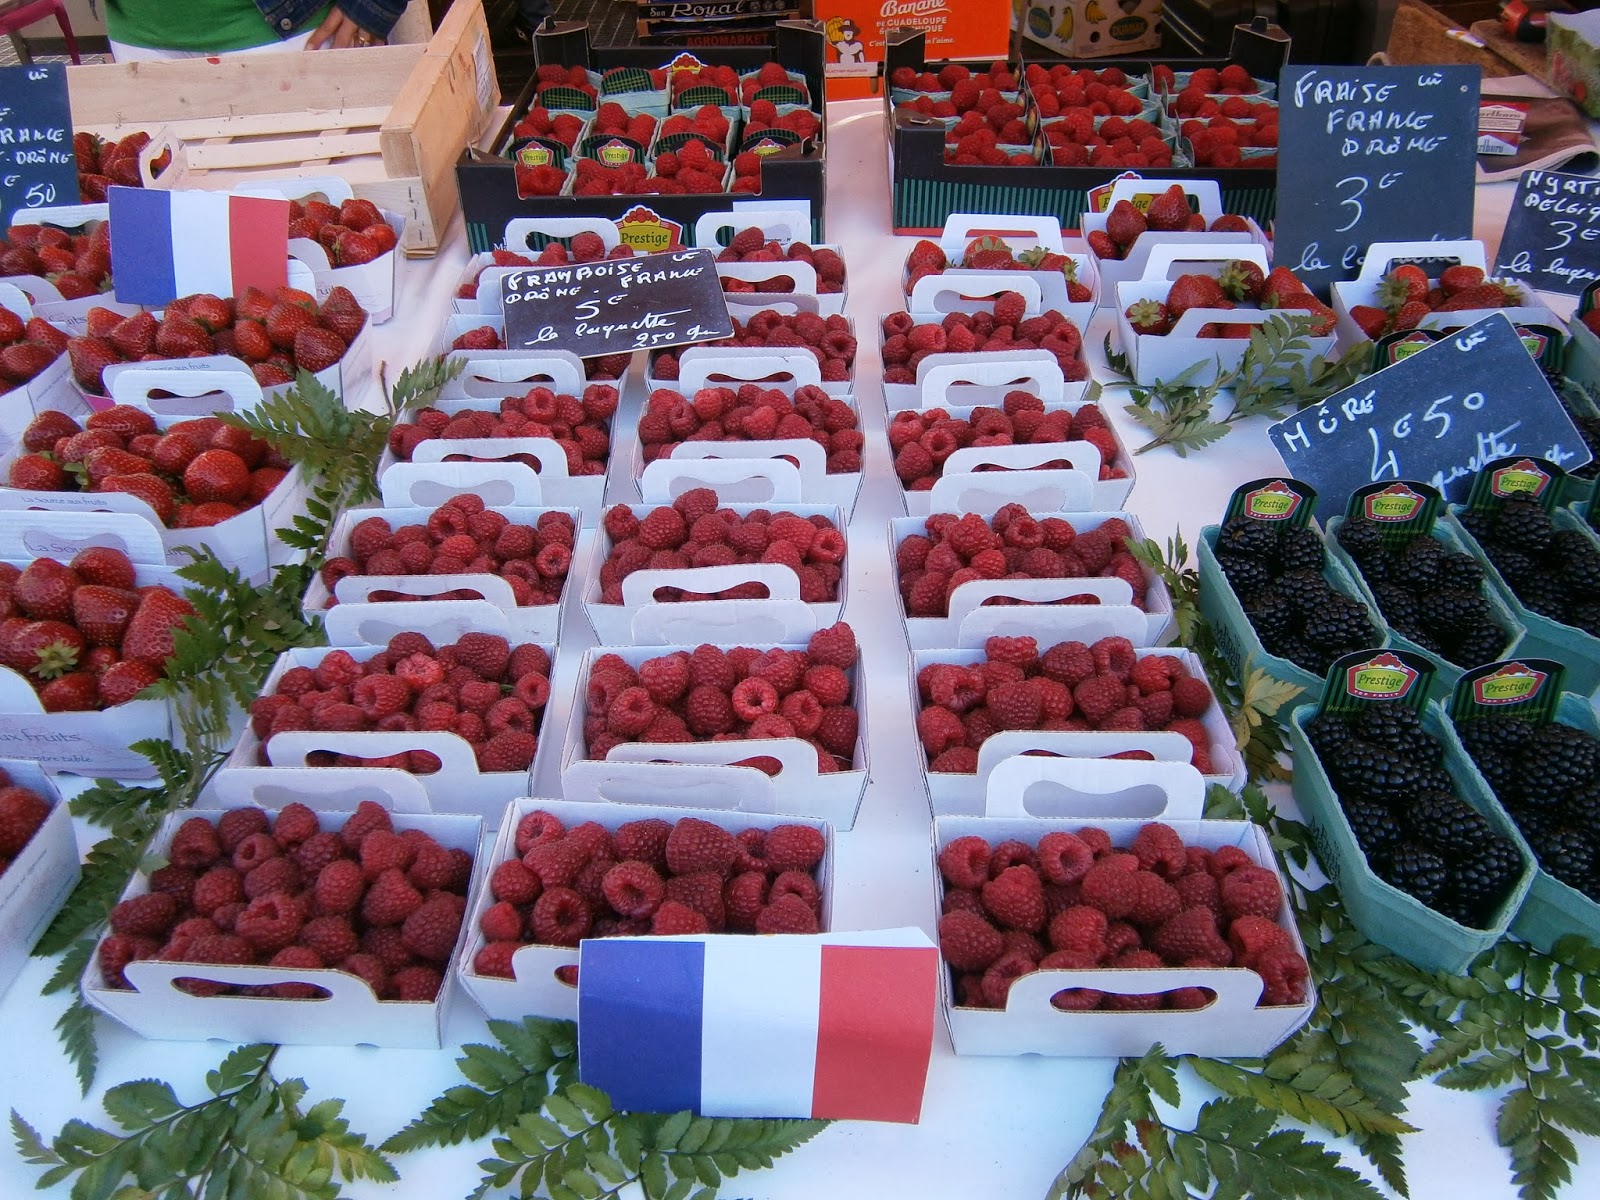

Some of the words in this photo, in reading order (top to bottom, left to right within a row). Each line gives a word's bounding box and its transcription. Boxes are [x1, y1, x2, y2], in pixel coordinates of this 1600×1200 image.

[650, 7, 666, 17] Sun
[670, 0, 745, 18] Royal
[880, 0, 946, 17] Banane
[887, 17, 947, 27] GUADELOUPE
[687, 33, 768, 47] AGROMARKET
[1294, 70, 1397, 107] FRAISE
[1479, 110, 1521, 118] arlboro
[1327, 109, 1433, 134] FRANCE
[0, 129, 64, 144] RANCE
[523, 153, 547, 162] Prestige
[604, 151, 628, 161] Prestige
[1526, 171, 1600, 196] MYRTI
[1525, 193, 1600, 223] BELGIQ
[621, 232, 668, 246] Prestige
[1291, 242, 1331, 271] la
[1500, 251, 1532, 273] la
[508, 262, 643, 290] FRAMBOISE
[525, 326, 558, 345] la
[632, 331, 675, 348] 250
[189, 362, 211, 370] fruits
[1500, 478, 1537, 490] Prestige
[82, 497, 107, 505] fruits
[1254, 499, 1288, 511] Prestige
[1374, 501, 1412, 513] Prestige
[1357, 674, 1402, 689] Prestige
[1486, 681, 1531, 694] Prestige
[21, 729, 81, 742] fruits
